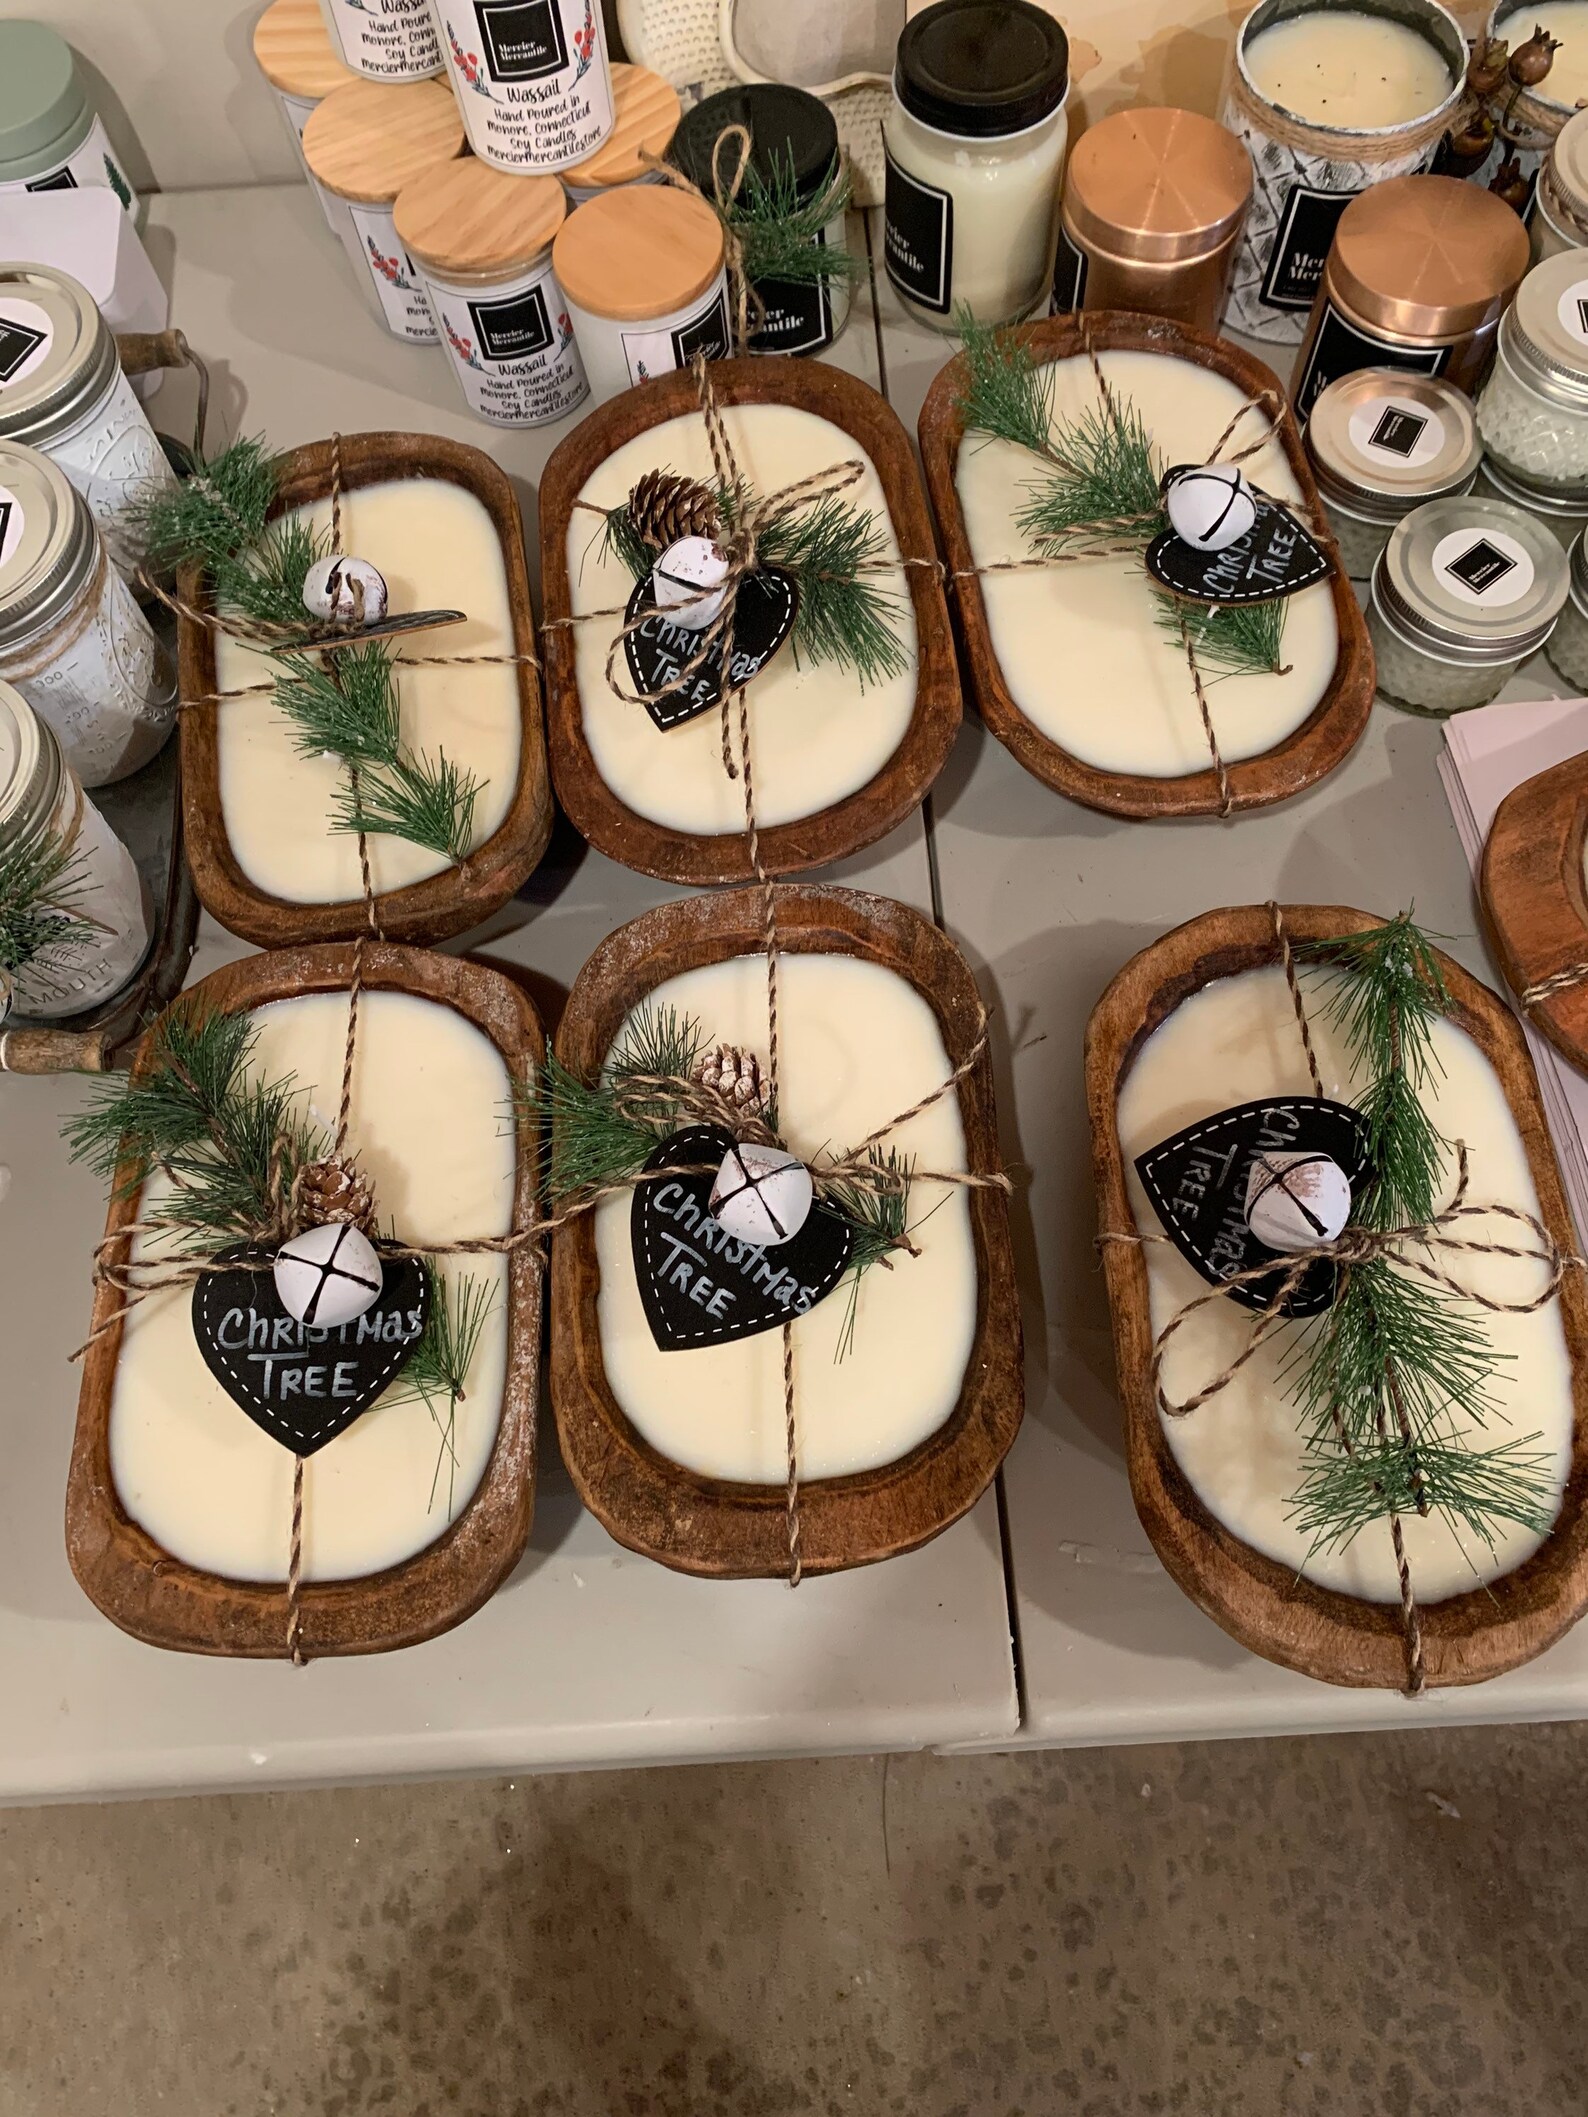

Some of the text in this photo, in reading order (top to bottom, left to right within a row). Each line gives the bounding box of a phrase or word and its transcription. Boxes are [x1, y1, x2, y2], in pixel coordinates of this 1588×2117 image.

[368, 20, 399, 32] Hand
[385, 48, 406, 61] Soy
[507, 79, 562, 104] Wassail
[494, 95, 580, 123] Hand Poured in
[510, 129, 577, 153] Soy Candles
[486, 363, 565, 390] Hand Poured in
[498, 354, 548, 377] Wassail
[501, 389, 562, 413] Soy Candles
